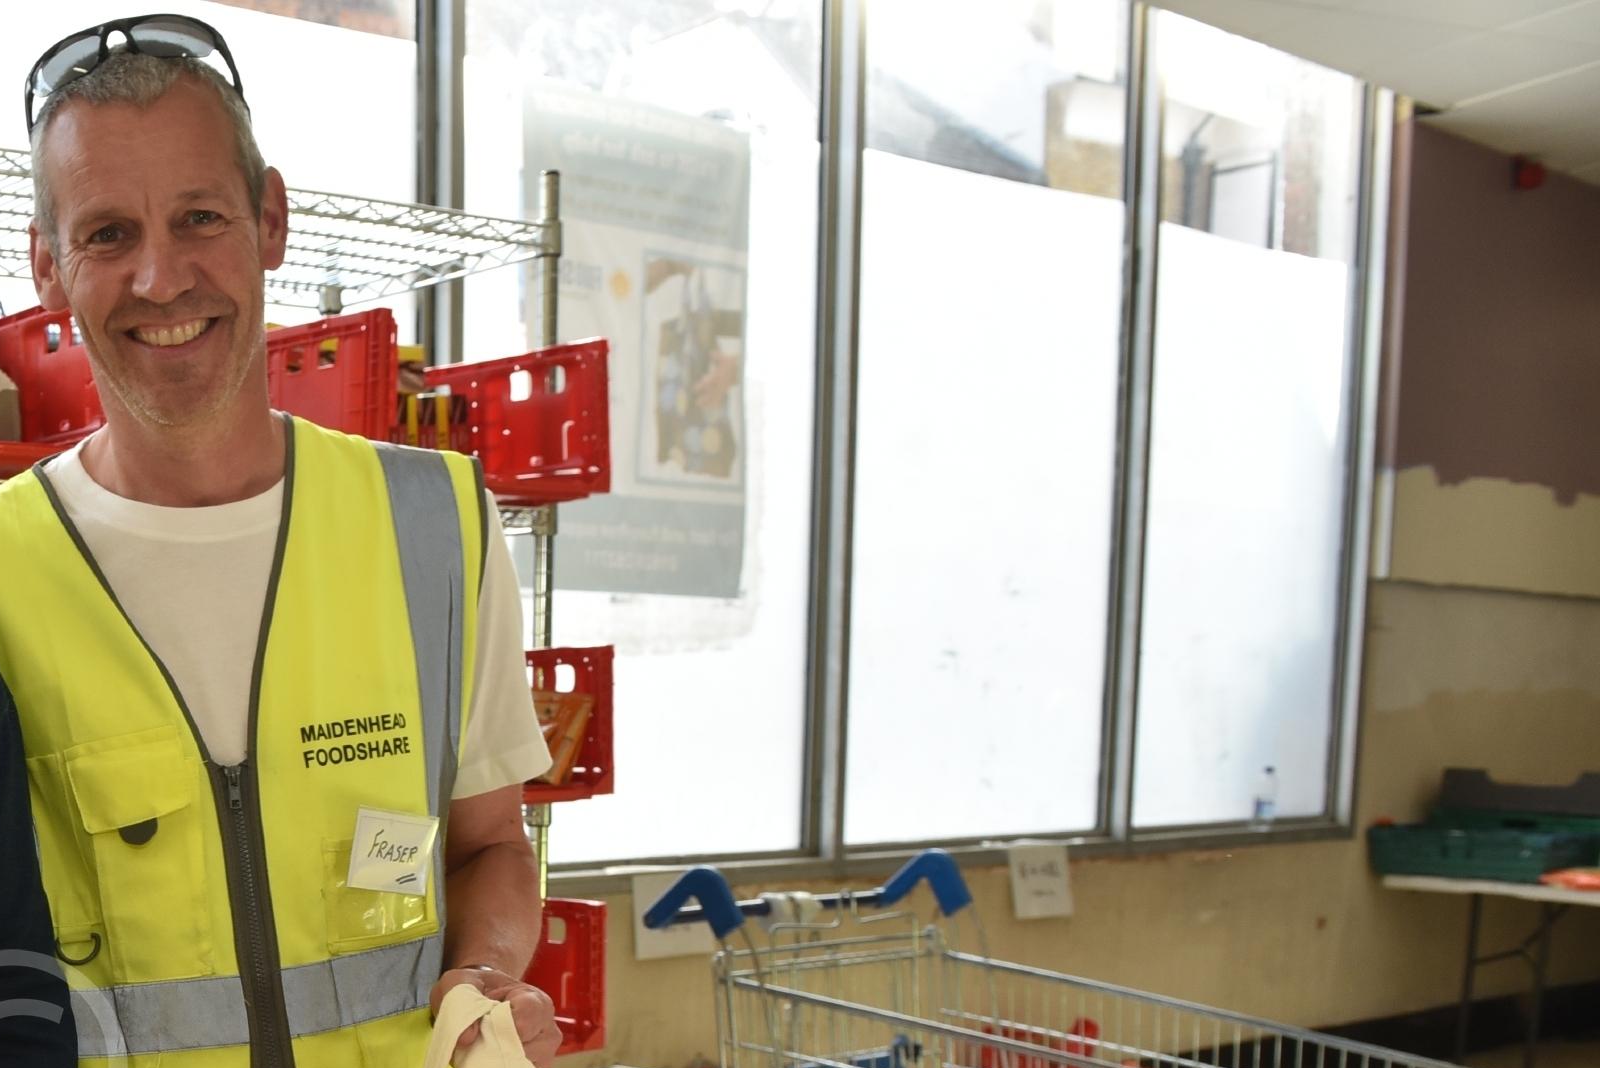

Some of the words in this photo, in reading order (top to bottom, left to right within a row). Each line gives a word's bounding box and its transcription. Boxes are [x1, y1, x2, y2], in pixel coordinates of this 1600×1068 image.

[300, 713, 406, 744] MAIDENHEAD
[303, 737, 411, 768] FOODSHARE
[367, 828, 418, 863] FRASER
